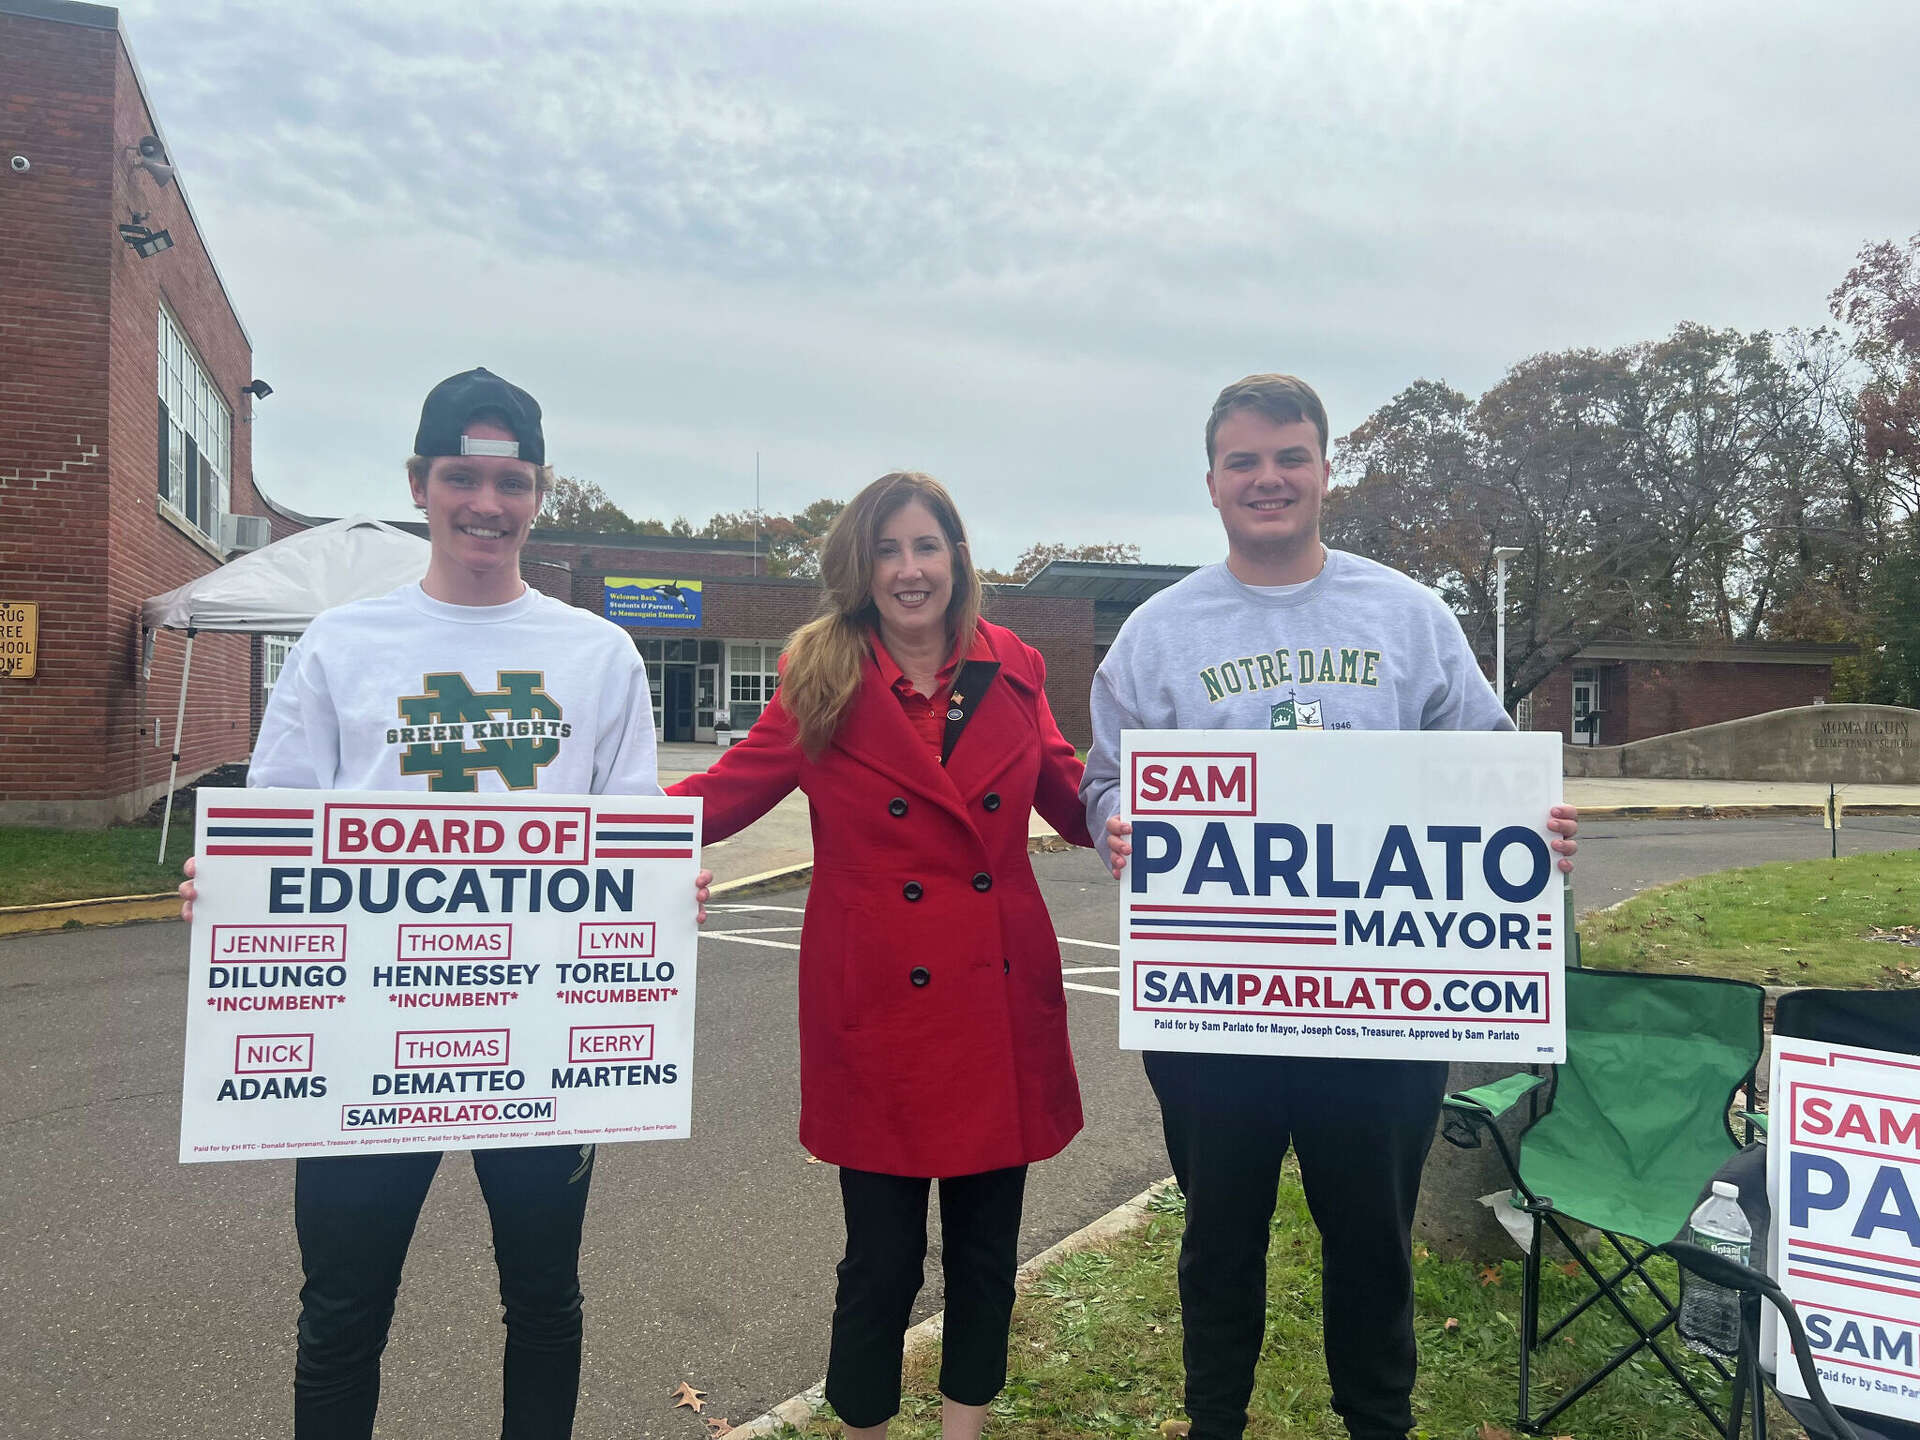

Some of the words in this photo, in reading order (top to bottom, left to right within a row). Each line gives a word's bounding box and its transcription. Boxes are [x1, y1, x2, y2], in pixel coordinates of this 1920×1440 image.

[658, 612, 696, 620] Elementary
[1200, 648, 1293, 703] NOTRE
[1298, 648, 1380, 687] DAME
[386, 725, 464, 744] GREEN
[472, 721, 572, 738] KNIGHTS
[1331, 722, 1351, 730] 1946
[1140, 764, 1246, 803] SAM
[338, 817, 505, 854] BOARD
[518, 819, 578, 854] OF
[1130, 820, 1552, 903] PARLATO
[269, 867, 634, 914] EDUCATION
[590, 931, 644, 949] LYNN
[1343, 910, 1531, 950] MAYOR
[222, 934, 336, 954] JENNIFER
[408, 933, 502, 952] THOMAS
[208, 965, 347, 989] DILUNGO
[373, 964, 540, 987] HENNESSEY
[556, 961, 675, 984] TORELLO
[1143, 970, 1539, 1014] SAMPARLATO.COM
[1154, 1019, 1173, 1029] Paid
[1175, 1020, 1187, 1029] for
[1189, 1020, 1199, 1032] by
[1201, 1021, 1220, 1031] Sam
[1223, 1021, 1254, 1032] Parlato
[1256, 1023, 1268, 1032] for
[1270, 1023, 1299, 1036] Mayor,
[1301, 1024, 1332, 1037] Joseph
[1335, 1026, 1359, 1037] Coss,
[1361, 1026, 1406, 1038] Treasurer.
[1408, 1027, 1450, 1040] Approved
[1452, 1028, 1463, 1041] by
[1465, 1028, 1485, 1040] Sam
[1487, 1029, 1520, 1041] Parlato
[247, 1044, 303, 1064] NICK
[406, 1040, 500, 1059] THOMAS
[579, 1035, 645, 1054] KERRY
[216, 1075, 328, 1101] ADAMS
[371, 1070, 526, 1096] DEMATTEO
[551, 1063, 678, 1090] MARTENS
[346, 1101, 552, 1127] SAMPARLATO.COM
[1800, 1098, 1920, 1150] SAM
[360, 1137, 392, 1145] Approved
[534, 1129, 555, 1137] Joseph
[1816, 1368, 1839, 1382] Paid
[1841, 1372, 1857, 1384] for
[1860, 1377, 1872, 1391] by
[1875, 1380, 1898, 1394] Sam
